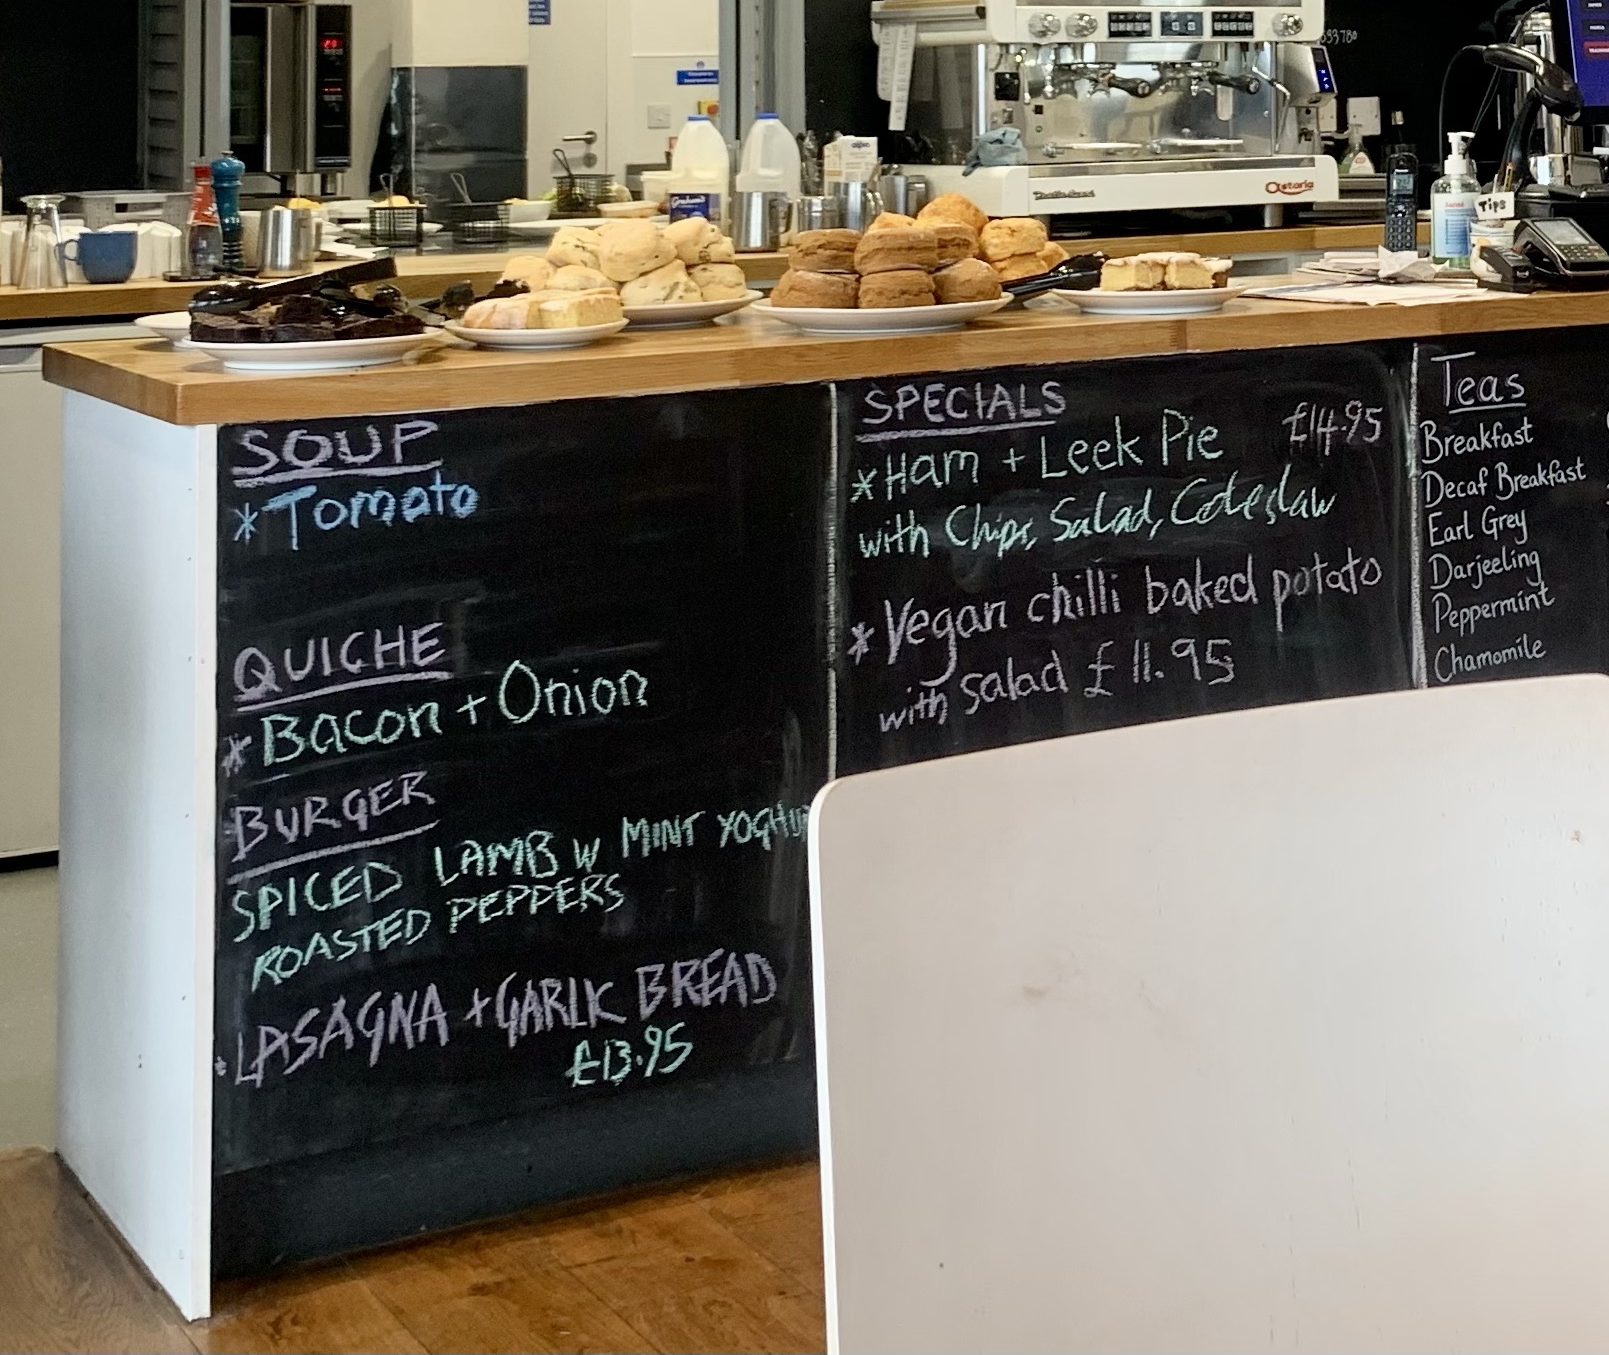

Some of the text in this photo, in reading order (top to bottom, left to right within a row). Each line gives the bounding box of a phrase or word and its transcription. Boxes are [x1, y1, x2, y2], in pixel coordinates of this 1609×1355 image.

[1478, 197, 1507, 213] Tips
[862, 382, 1066, 425] SPECIALS
[1431, 352, 1525, 406] Teas
[231, 420, 438, 474] SOUP
[886, 410, 1223, 501] Ham Leek Pie
[1282, 400, 1383, 456] £14.95
[1421, 417, 1533, 463] Breakfast
[261, 470, 478, 550] Tomato
[858, 508, 929, 559] with
[1050, 490, 1163, 542] Salad,
[1171, 464, 1338, 526] Coleslaw
[1422, 458, 1586, 507] Decaf Breakfast
[1428, 507, 1527, 546] Earl Grey
[1430, 548, 1542, 586] Darjeeling
[884, 548, 1382, 687] Vegan chilli baked potato
[1432, 583, 1555, 636] Peppermint
[234, 622, 448, 702] QUICHE
[1434, 634, 1546, 682] Chamomile
[261, 660, 648, 766] Bacon Onion
[880, 650, 1068, 732] with salad
[230, 772, 435, 862] BURGER
[232, 812, 703, 942] SPICED LAMB MINT
[252, 874, 626, 990] ROASTED PEPPERS
[234, 949, 777, 1087] LASAGNA BREAD
[565, 1022, 693, 1087] £13.95
